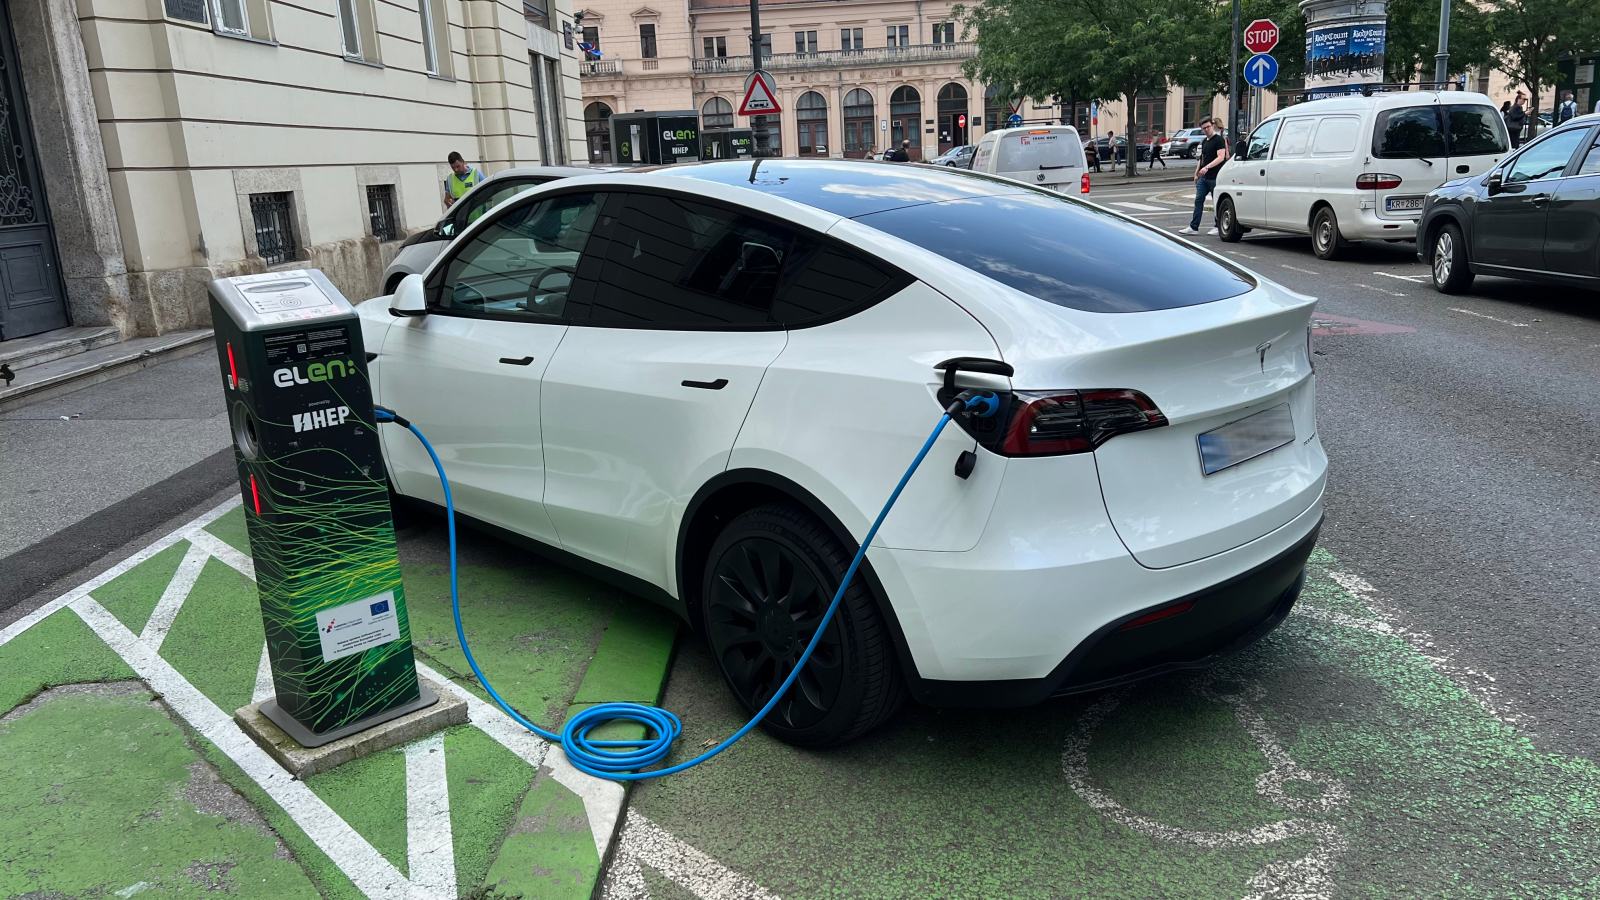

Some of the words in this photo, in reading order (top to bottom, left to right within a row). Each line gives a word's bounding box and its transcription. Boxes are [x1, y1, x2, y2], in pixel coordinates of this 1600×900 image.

[1247, 29, 1276, 45] STOP
[1391, 200, 1401, 209] KR
[312, 405, 350, 429] HEP
